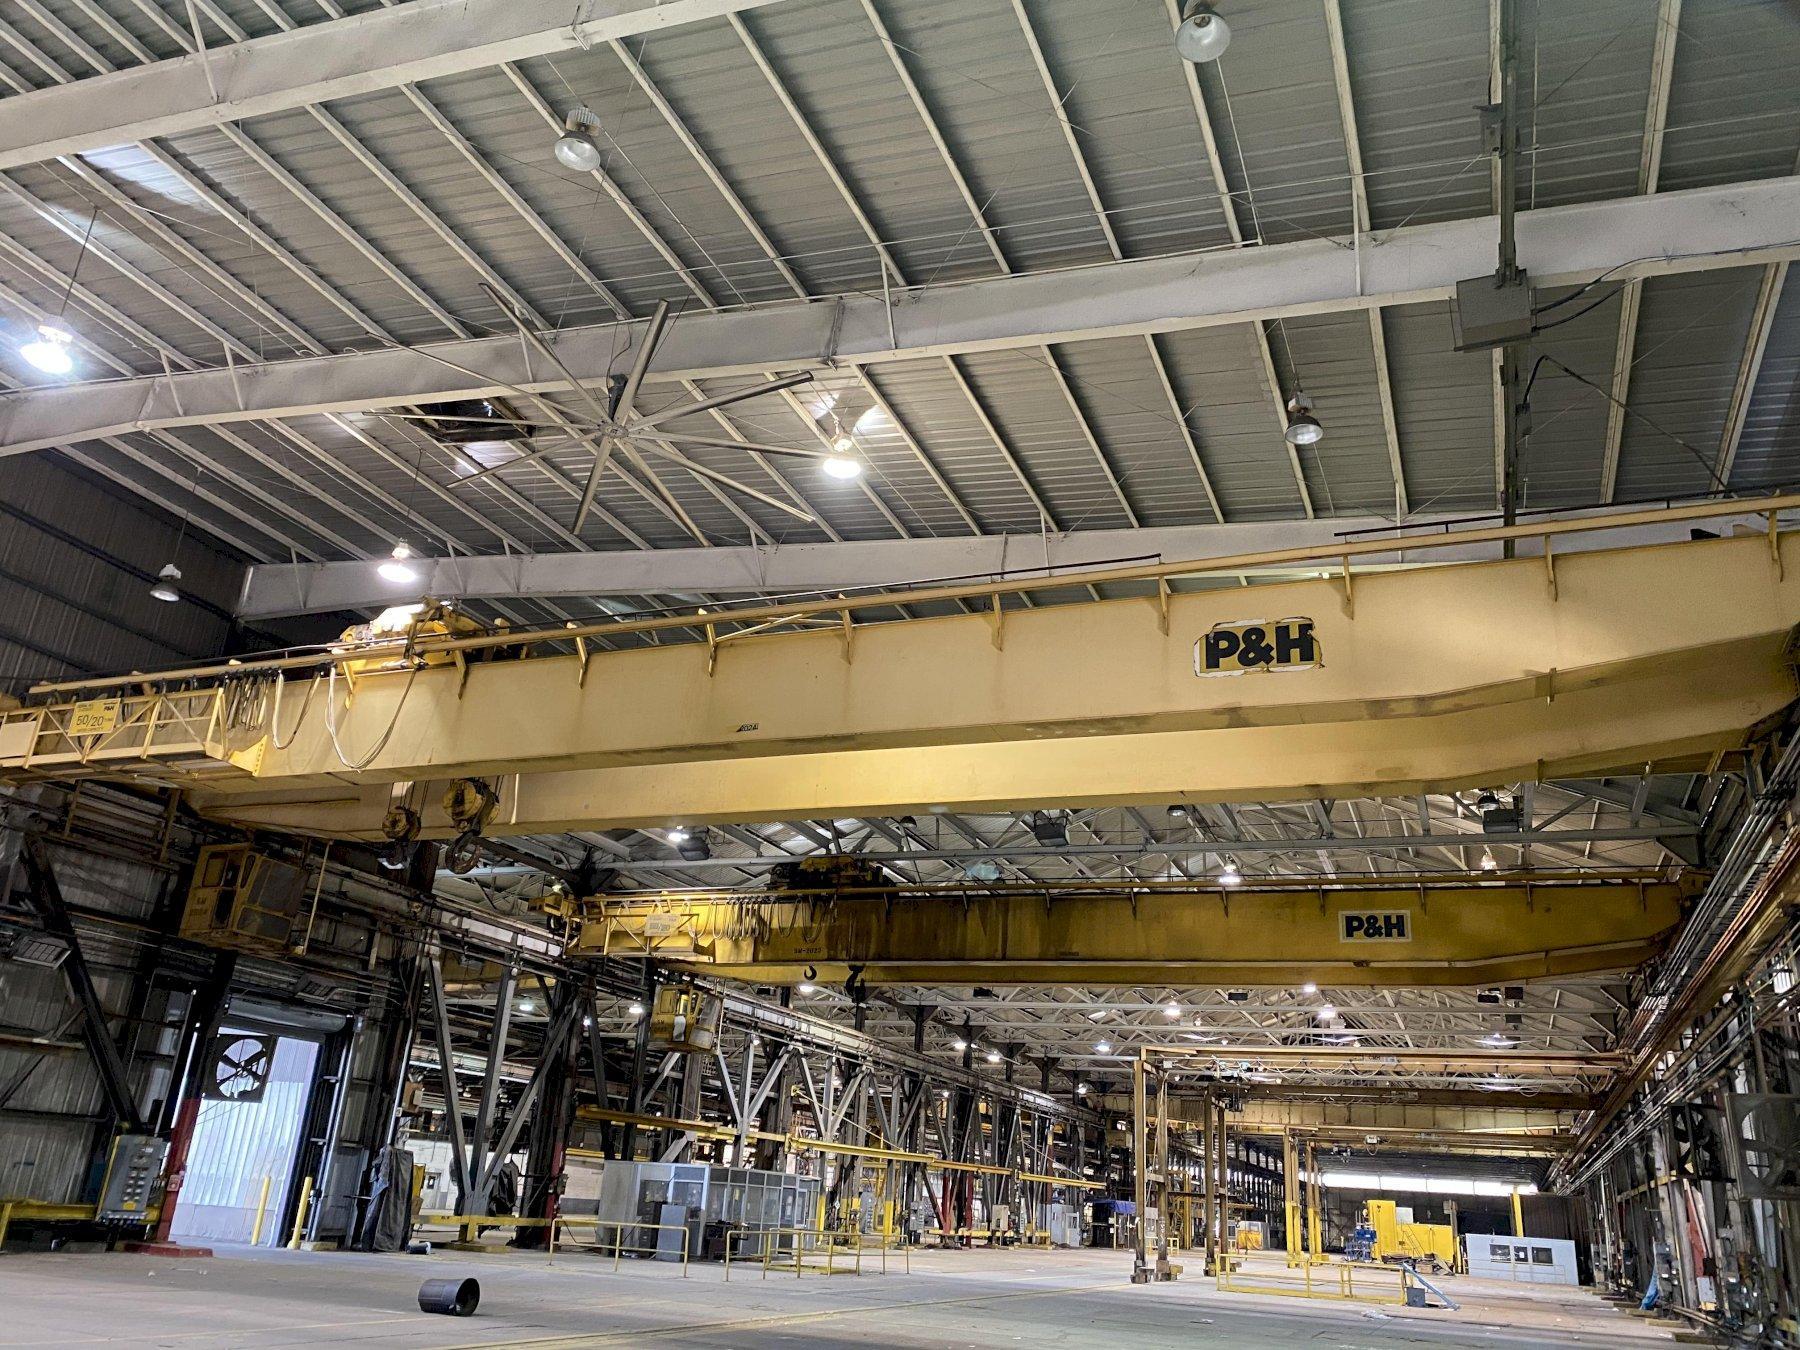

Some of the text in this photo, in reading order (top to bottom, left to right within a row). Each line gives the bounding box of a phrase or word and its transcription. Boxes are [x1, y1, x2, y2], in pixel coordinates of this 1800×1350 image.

[1205, 623, 1315, 669] P&H
[76, 714, 104, 727] 50/20
[1344, 914, 1406, 938] P&H
